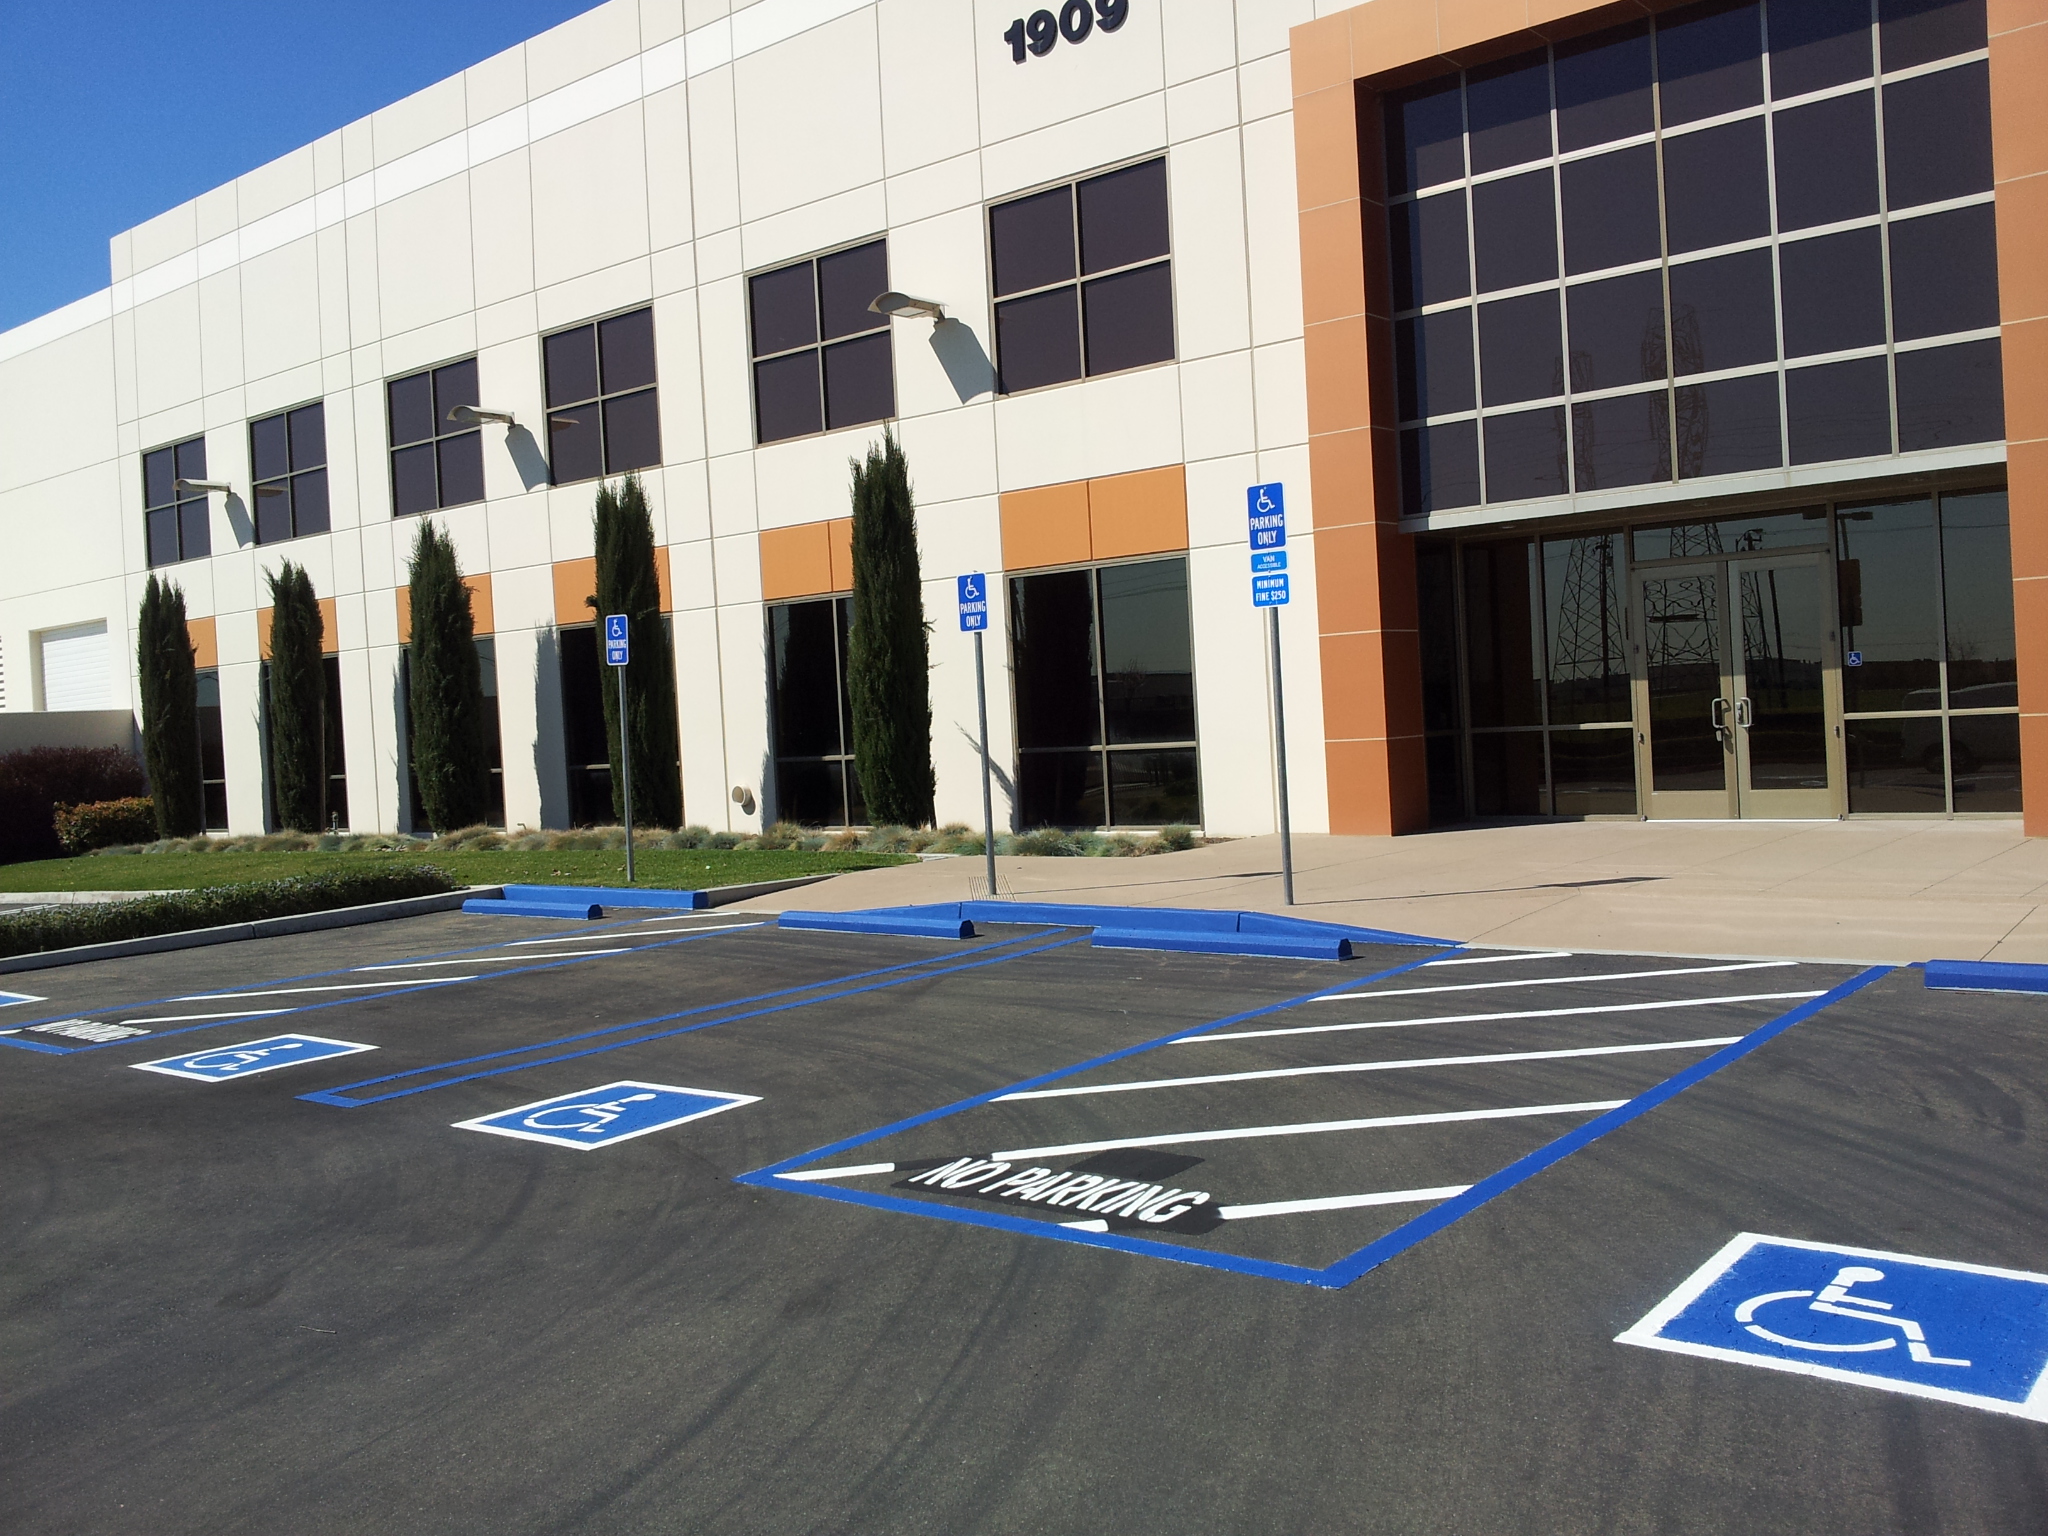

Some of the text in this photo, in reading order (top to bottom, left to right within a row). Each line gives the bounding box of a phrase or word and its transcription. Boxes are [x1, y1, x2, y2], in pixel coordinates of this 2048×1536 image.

[1004, 0, 1129, 65] 1909
[1250, 513, 1283, 530] PARKING
[1257, 530, 1277, 545] ONLY
[1256, 561, 1282, 569] ACCESSIBLE
[1262, 554, 1275, 563] VAN
[1256, 578, 1284, 590] MINIMUM
[1255, 590, 1287, 602] FINE $250
[960, 600, 986, 615] PARKING
[965, 614, 982, 628] ONLY
[908, 1156, 1211, 1224] NO PARKING
